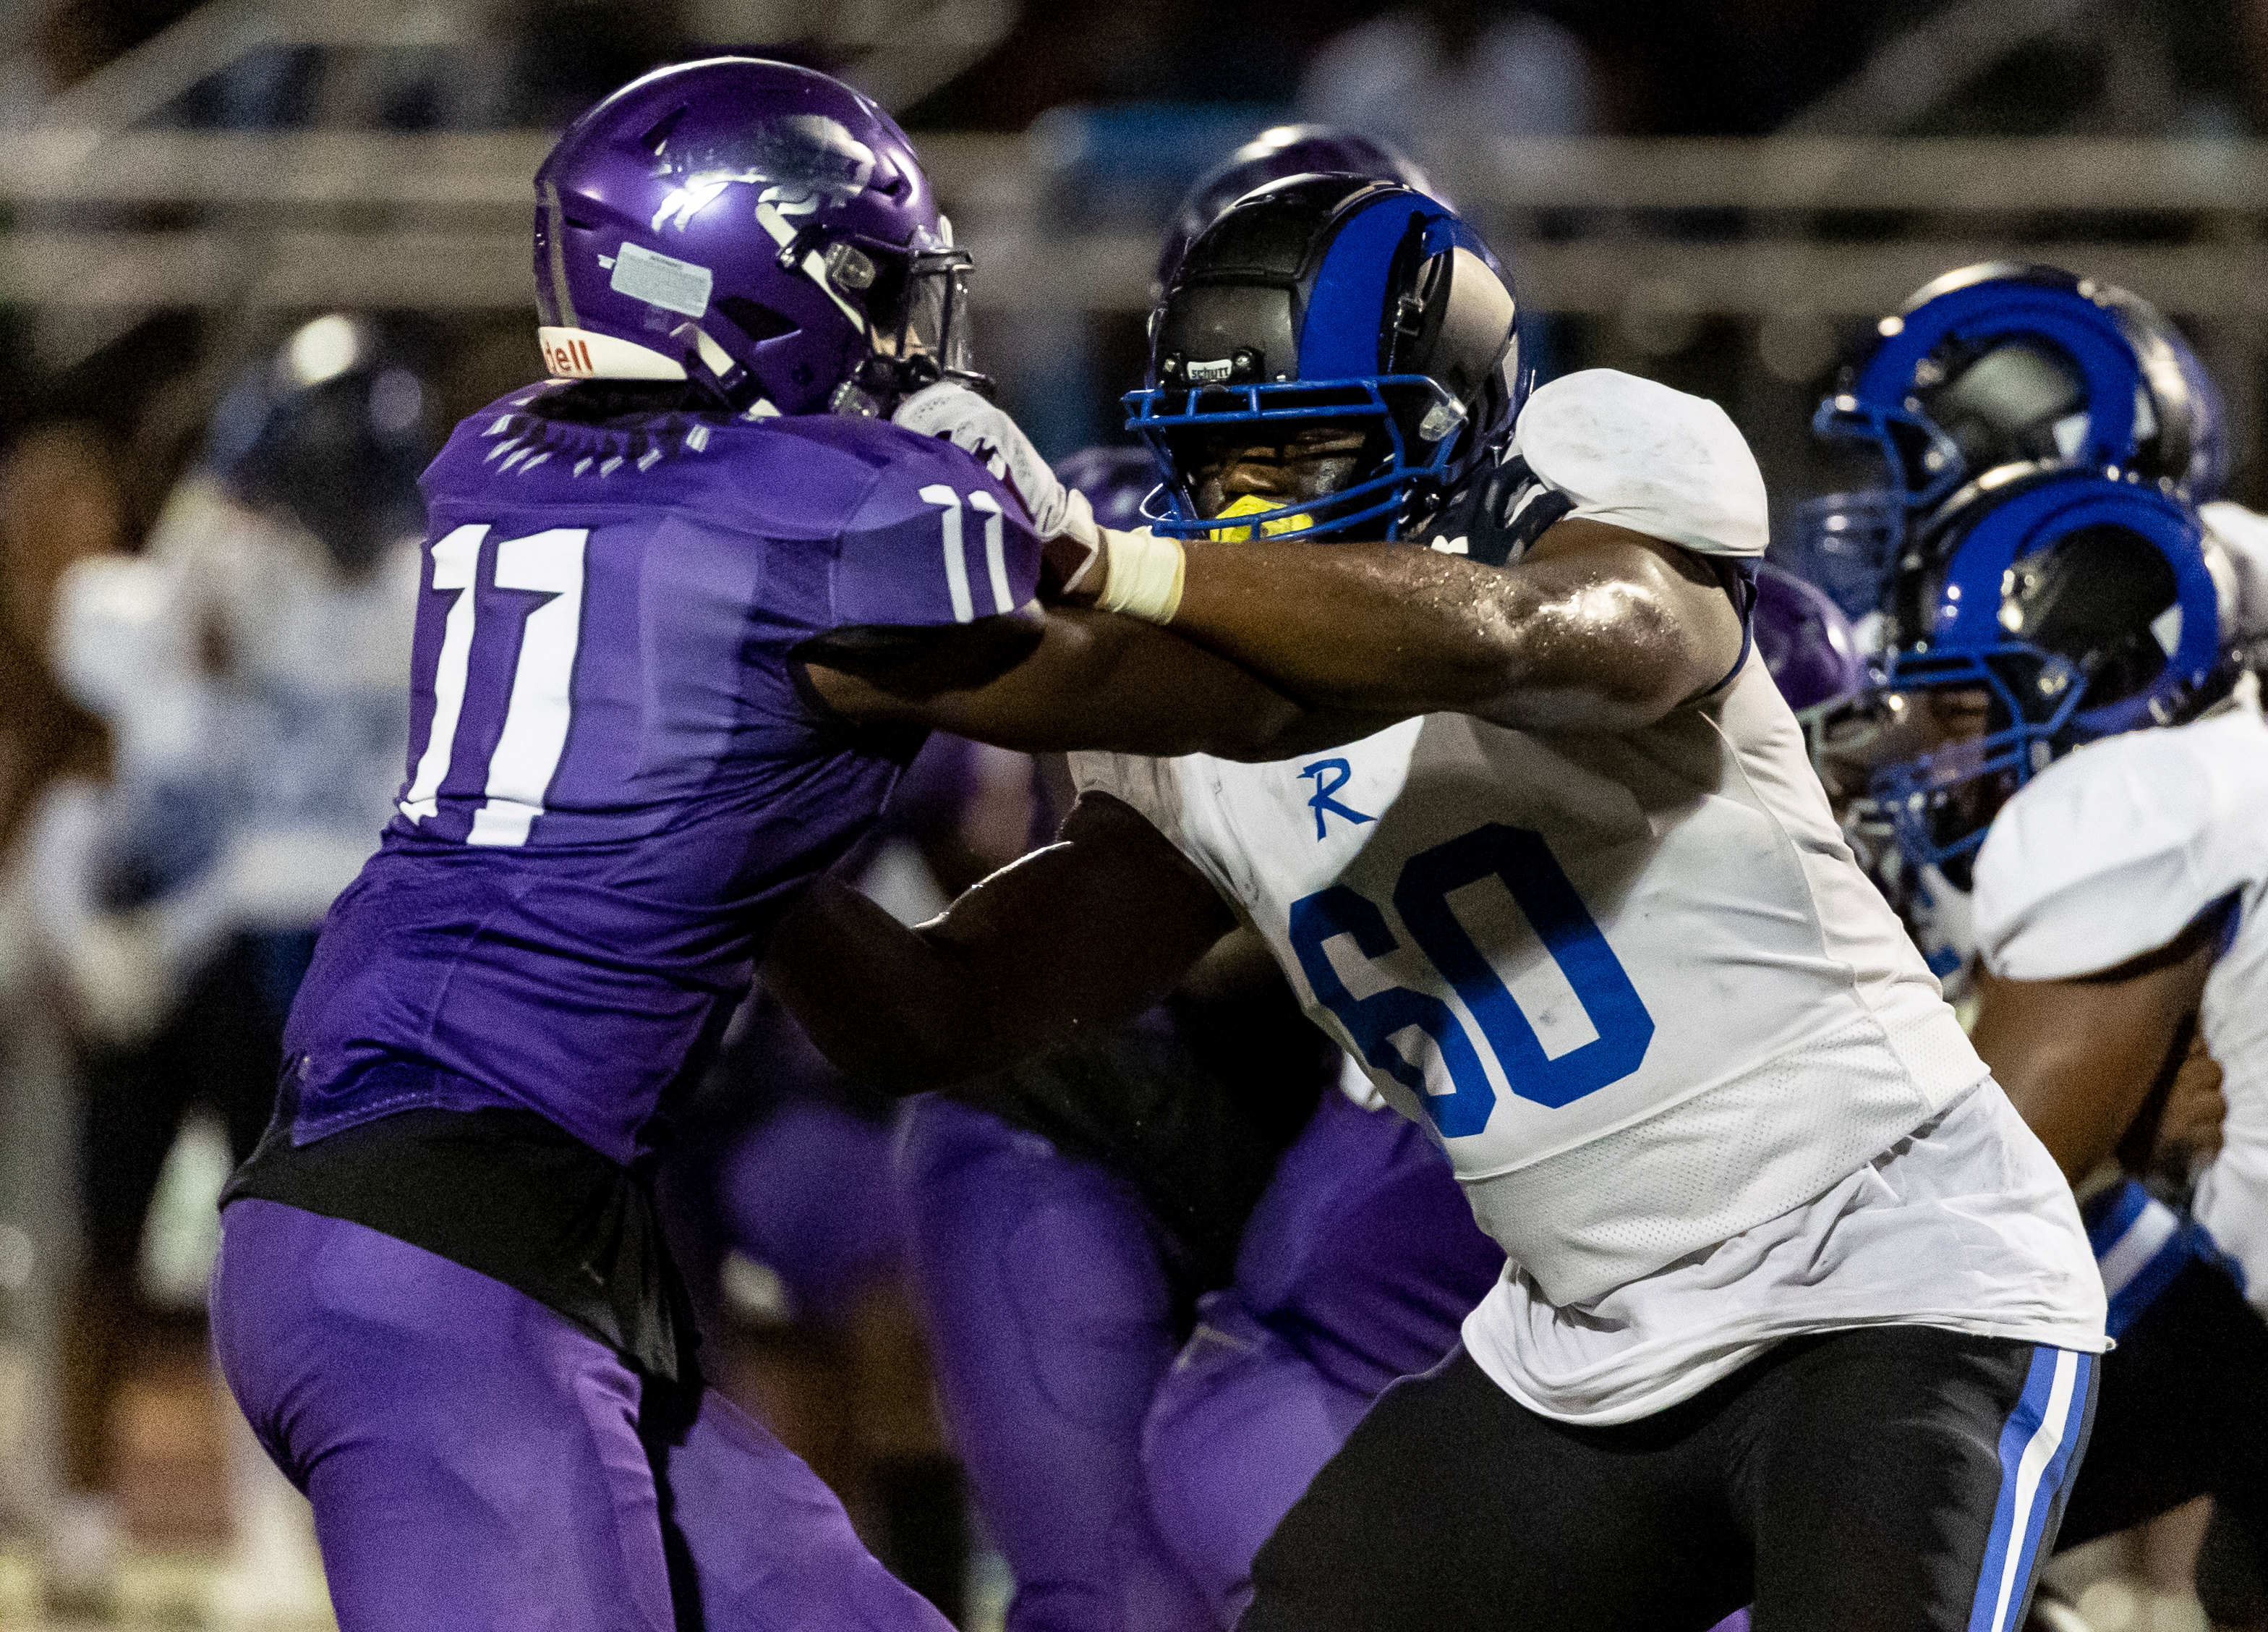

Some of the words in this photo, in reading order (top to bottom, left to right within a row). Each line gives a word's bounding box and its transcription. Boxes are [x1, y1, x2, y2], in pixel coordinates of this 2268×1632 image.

[918, 484, 1015, 624] 11
[398, 524, 589, 846] 11
[1297, 757, 1378, 842] R
[1289, 822, 1655, 1139] 60
